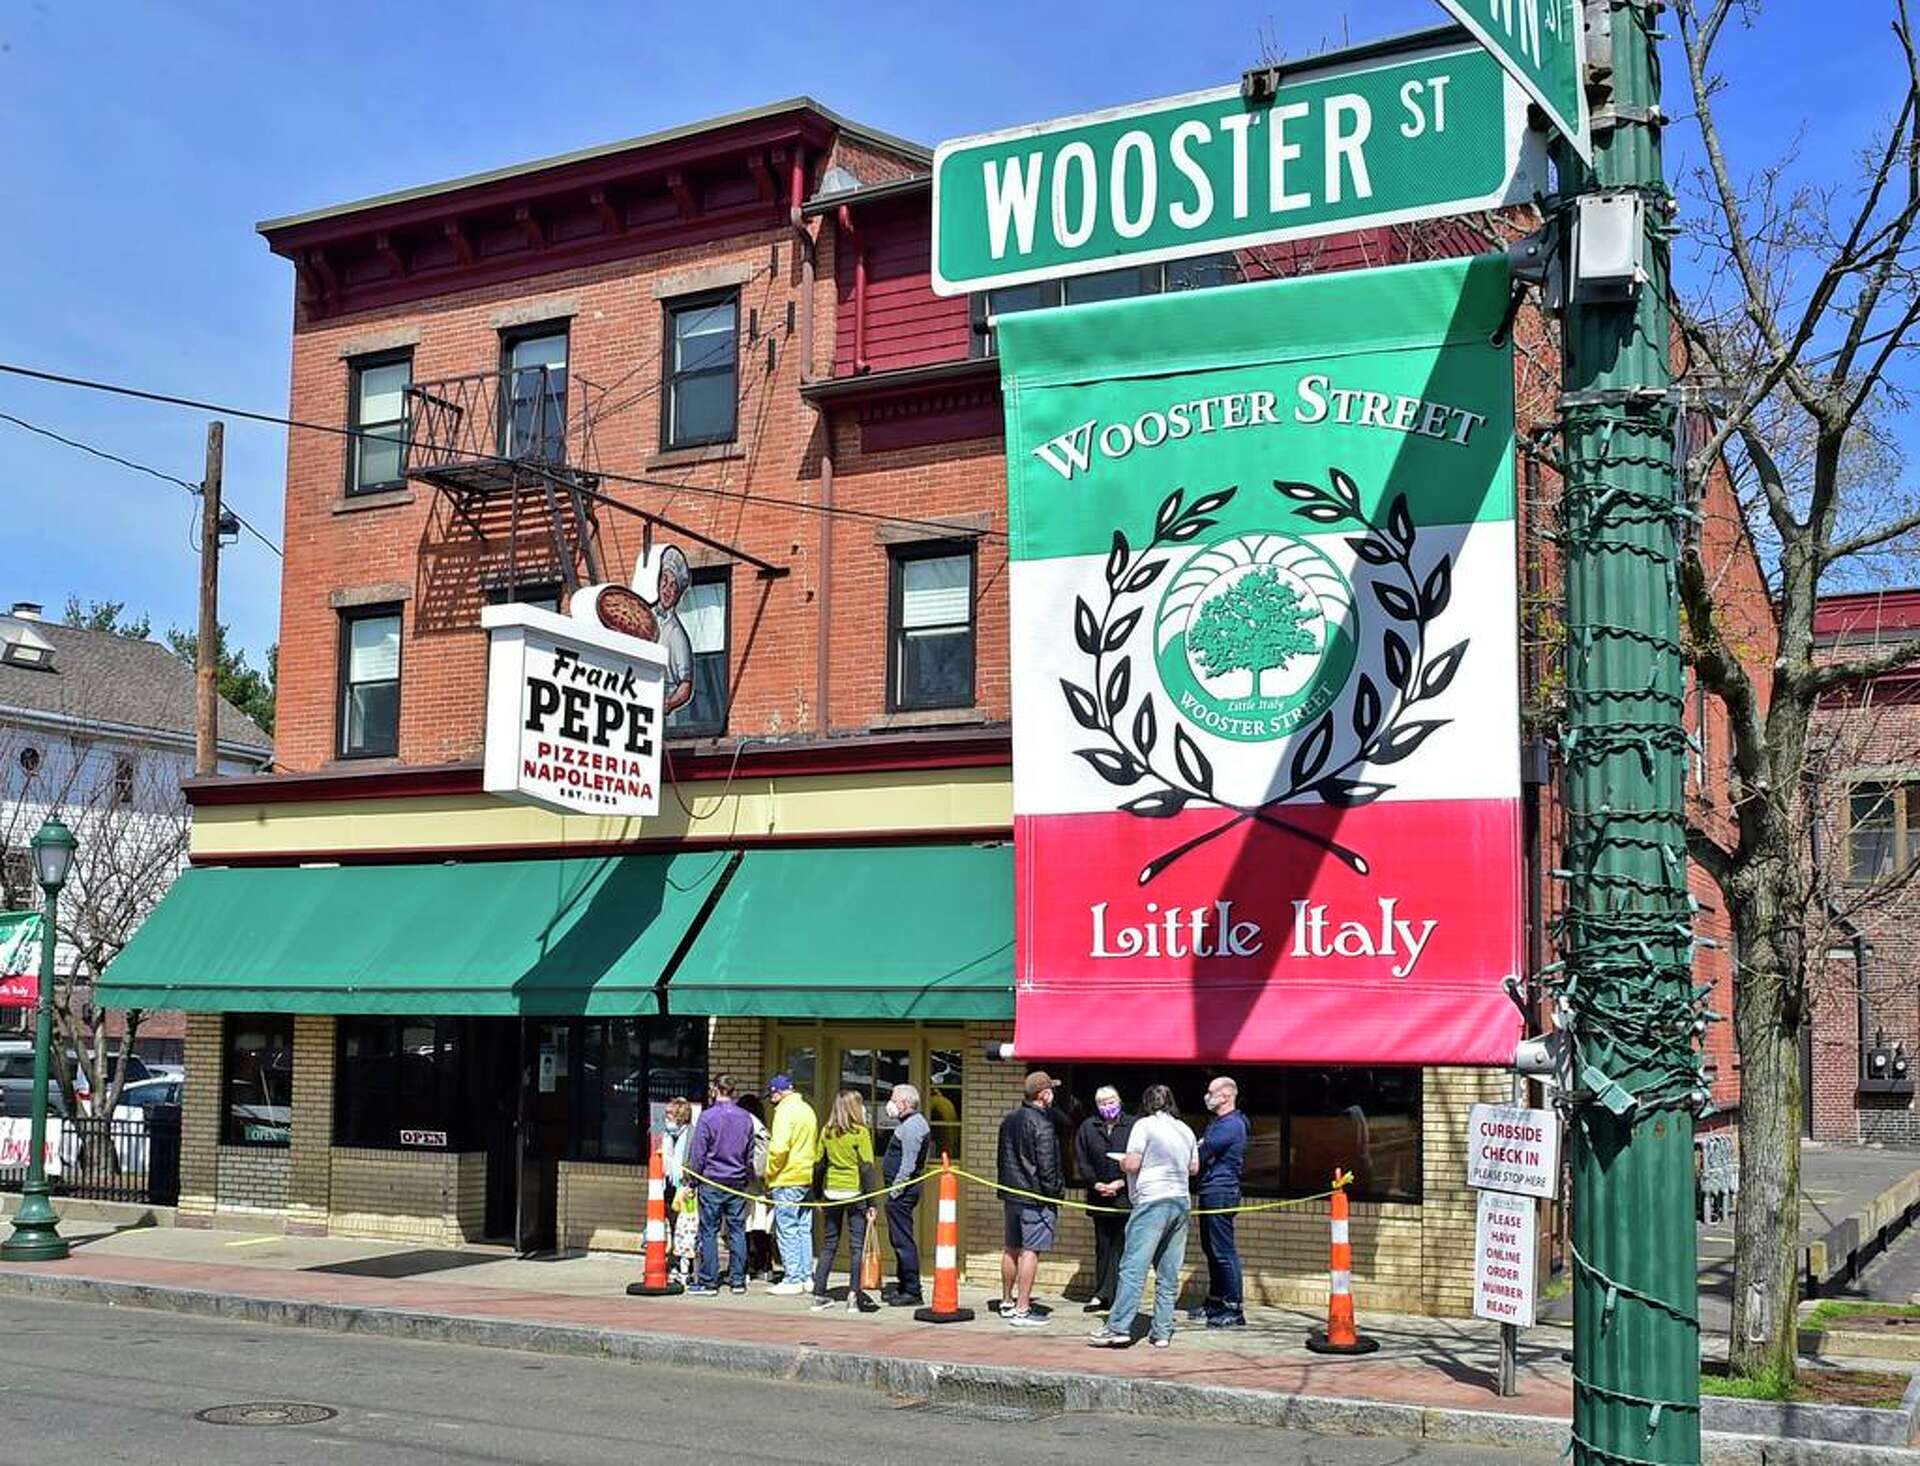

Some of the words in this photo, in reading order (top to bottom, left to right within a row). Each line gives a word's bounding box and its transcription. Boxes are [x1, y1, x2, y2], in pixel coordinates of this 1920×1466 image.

[983, 93, 1373, 260] WOOSTER
[1400, 75, 1450, 139] ST
[1030, 390, 1281, 480] WOOSTER
[1294, 374, 1487, 447] STREET
[552, 647, 639, 700] Frank
[1180, 690, 1266, 735] WOOSTER
[1270, 680, 1334, 733] STREET
[1228, 699, 1257, 712] Little
[1259, 699, 1285, 712] Italy
[525, 676, 654, 757] PEPE
[538, 742, 641, 778] PIZZERIA
[523, 760, 653, 800] NAPOLETANA
[1090, 899, 1263, 958] Little
[1290, 897, 1438, 978] Italy
[403, 1132, 444, 1144] OPEN
[1480, 1122, 1543, 1142] CURBSIDE
[1482, 1145, 1523, 1165] CHECK
[1525, 1150, 1539, 1166] IN
[1474, 1167, 1502, 1182] PLEASE
[1503, 1171, 1525, 1184] STOP
[1525, 1174, 1546, 1187] HERE
[1488, 1212, 1522, 1228] PLEASE
[1491, 1231, 1516, 1245] HAVE
[1486, 1248, 1520, 1264] ONLINE
[1486, 1265, 1520, 1281] ORDER
[1482, 1281, 1523, 1300] NUMBER
[1486, 1300, 1517, 1316] READY
